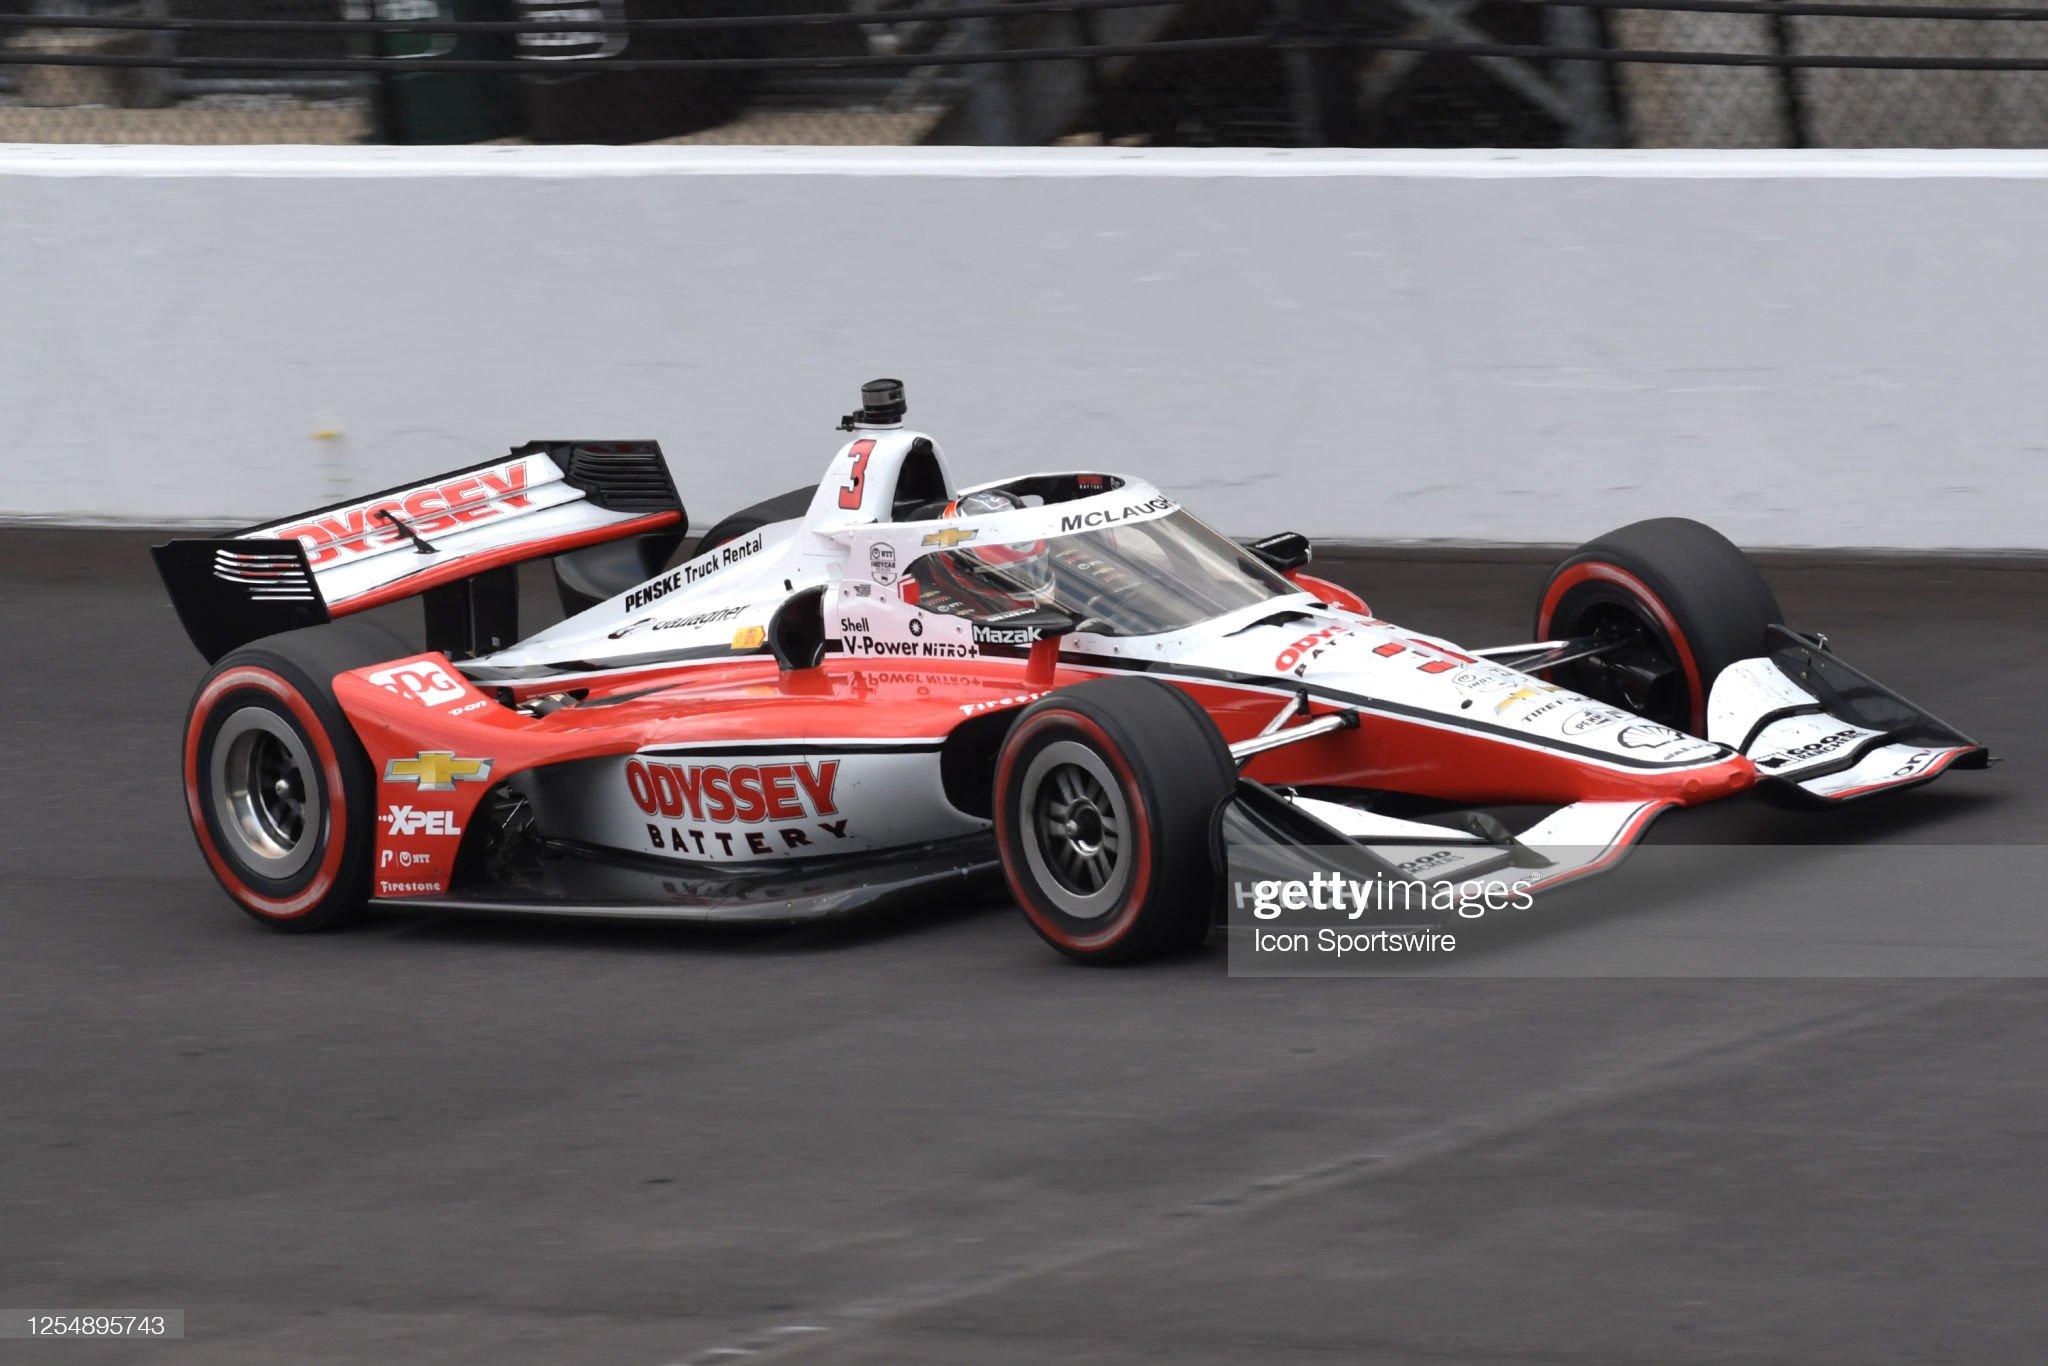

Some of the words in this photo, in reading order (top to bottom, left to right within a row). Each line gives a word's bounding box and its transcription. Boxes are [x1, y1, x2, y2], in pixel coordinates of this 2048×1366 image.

[838, 438, 878, 511] 3
[275, 460, 536, 566] DYSSEY
[624, 571, 682, 613] PENSKE
[684, 554, 720, 585] Truck
[722, 532, 763, 568] Rental
[840, 617, 870, 632] Shell
[972, 625, 1044, 644] Mazak
[843, 635, 919, 656] V-Power
[959, 690, 1053, 717] Firest
[1786, 729, 1857, 755] GOOD
[625, 757, 841, 824] ODYSSEY
[388, 804, 462, 836] XPEL
[646, 818, 849, 857] BATTERY
[1399, 851, 1452, 869] OOD
[380, 880, 441, 893] Firestone
